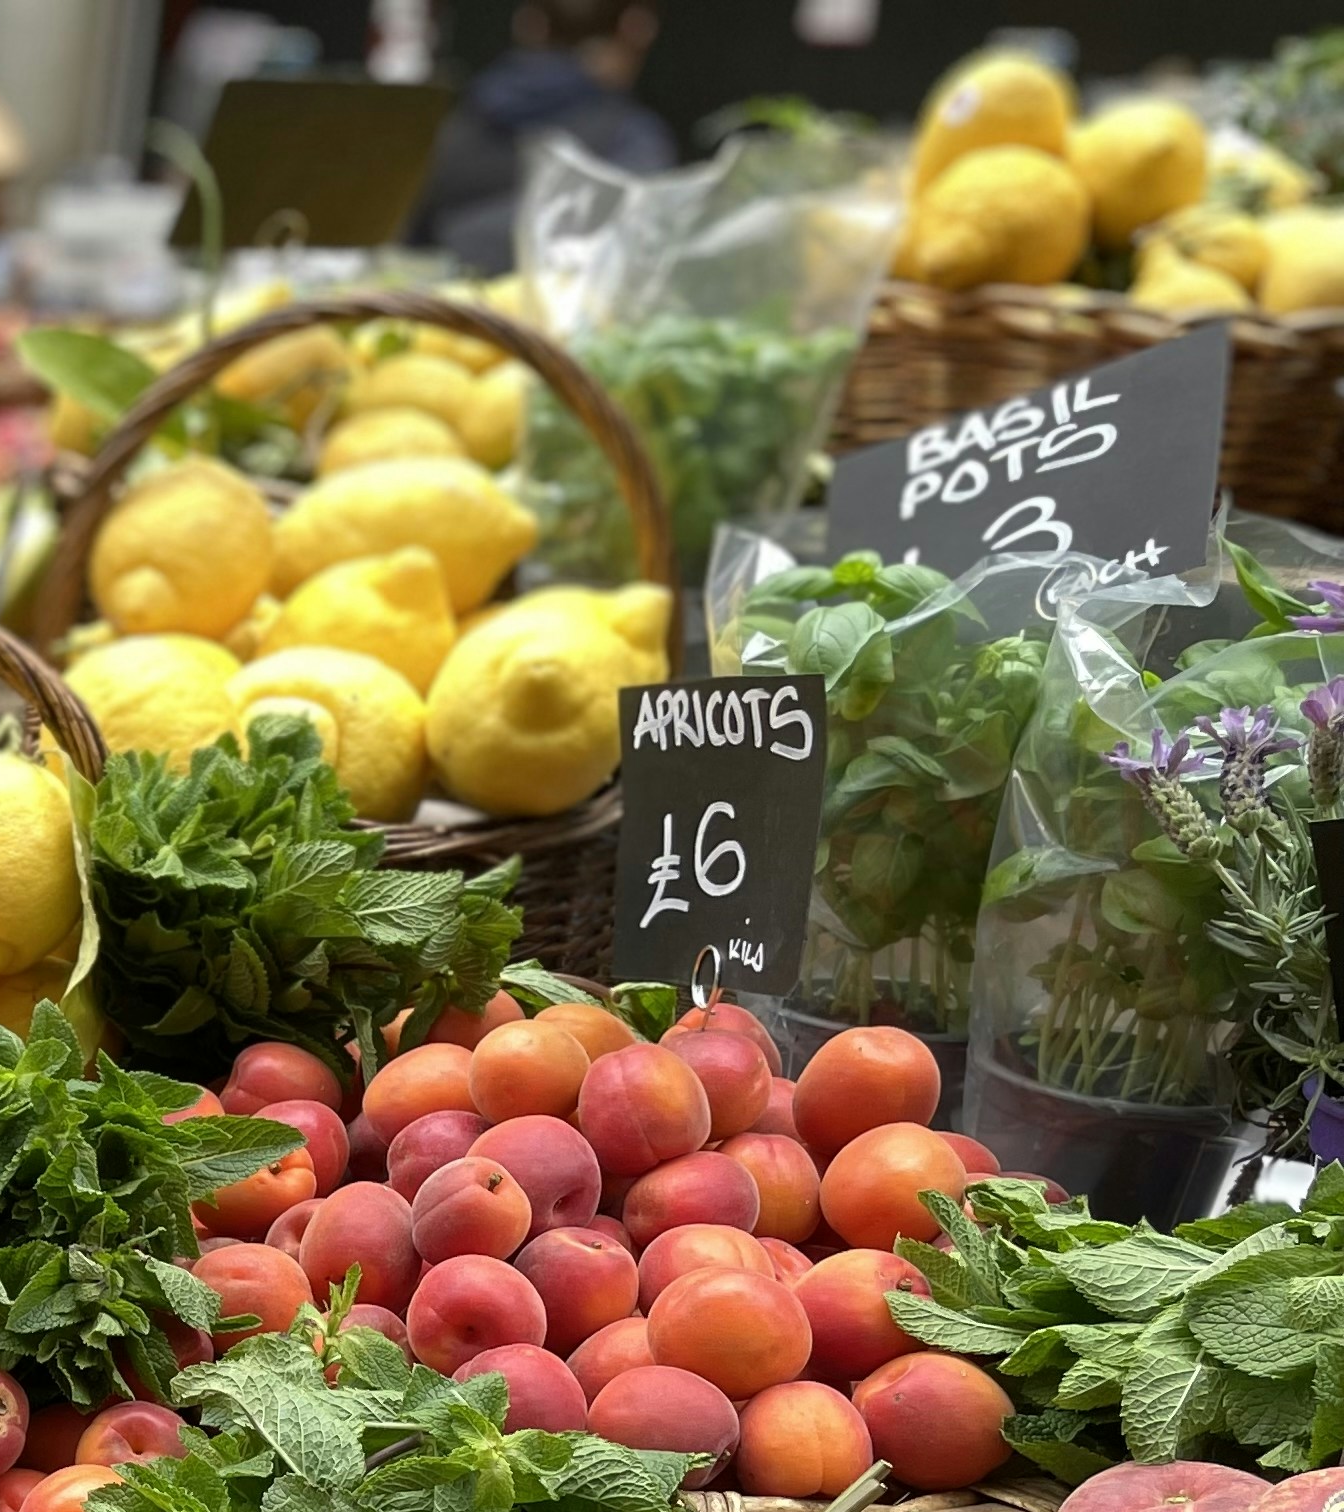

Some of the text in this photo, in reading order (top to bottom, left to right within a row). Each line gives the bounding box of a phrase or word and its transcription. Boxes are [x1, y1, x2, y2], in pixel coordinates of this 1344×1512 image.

[899, 422, 1118, 520] POTS
[907, 377, 1122, 475] BASIL
[632, 685, 813, 761] APRICOTS
